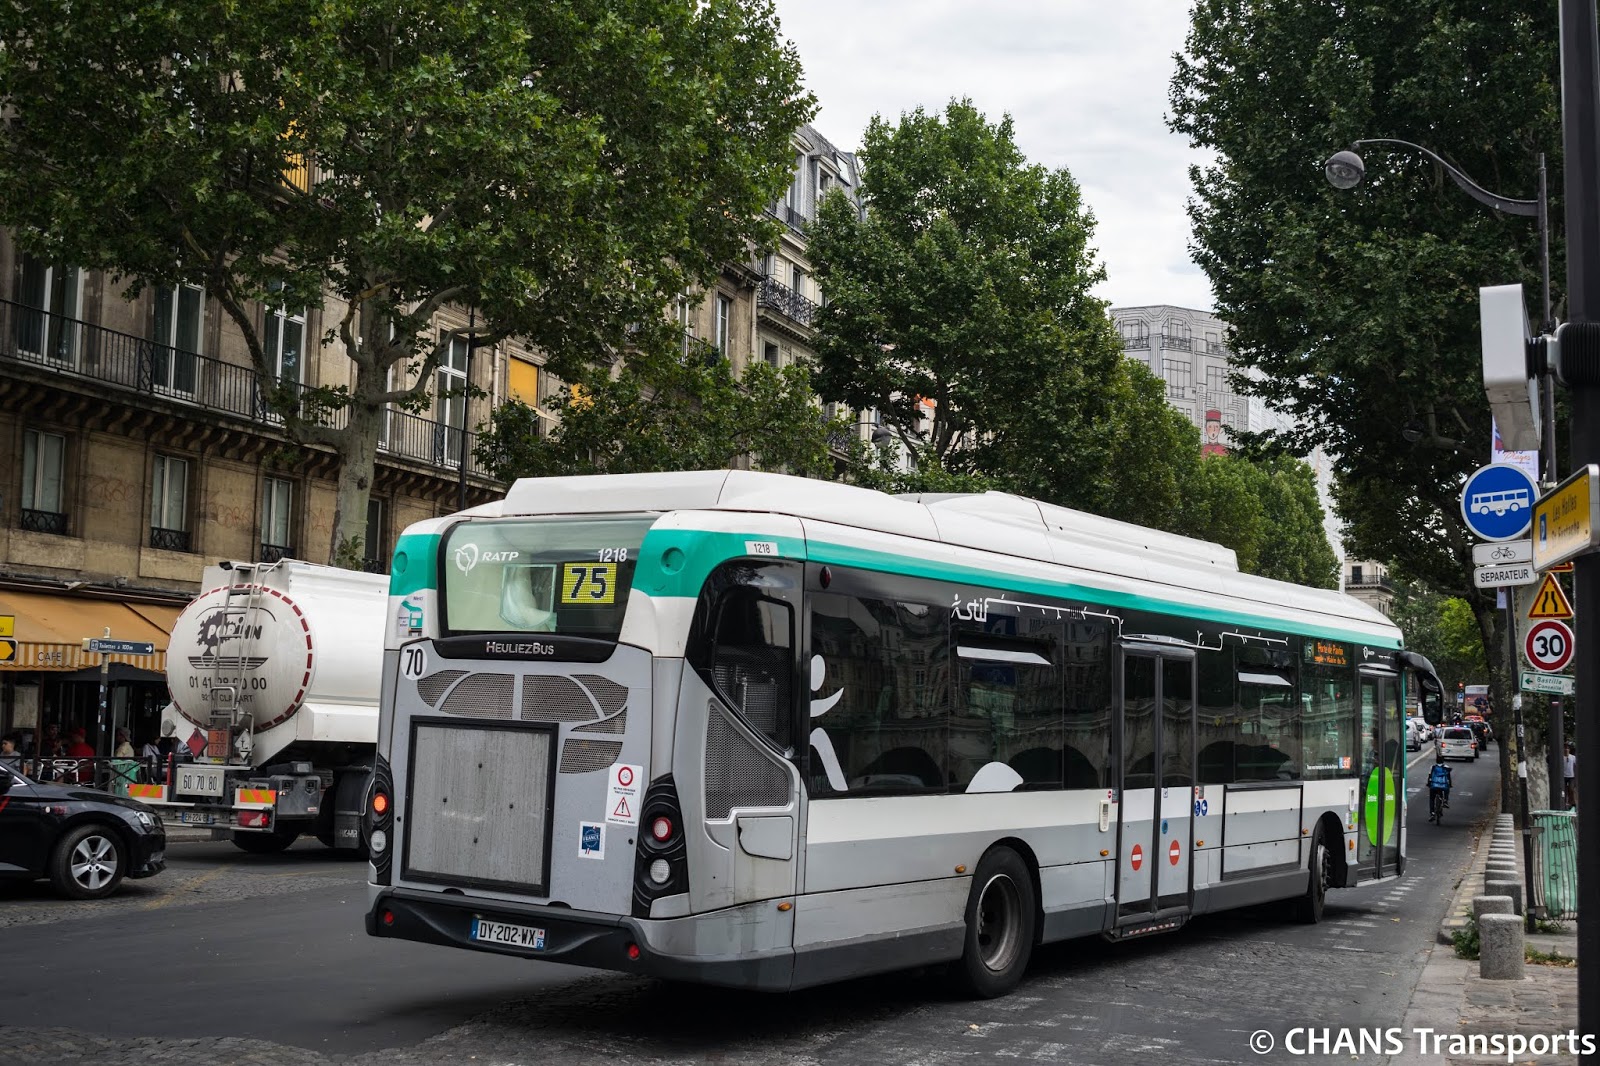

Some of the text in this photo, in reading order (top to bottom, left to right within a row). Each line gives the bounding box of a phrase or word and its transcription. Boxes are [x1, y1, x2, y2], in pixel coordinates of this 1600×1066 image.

[598, 547, 627, 562] 1218
[753, 543, 771, 554] 1218
[481, 551, 519, 562] RATP
[570, 566, 608, 600] 75
[1480, 568, 1530, 583] SEPARATEUR
[1535, 634, 1564, 657] 30
[405, 648, 424, 676] 70
[251, 677, 267, 690] 00
[1536, 676, 1563, 685] Bastille
[219, 694, 253, 702] CLAART
[183, 775, 217, 791] 60 70 80
[479, 922, 536, 946] DY-202-WX
[537, 940, 544, 948] 75
